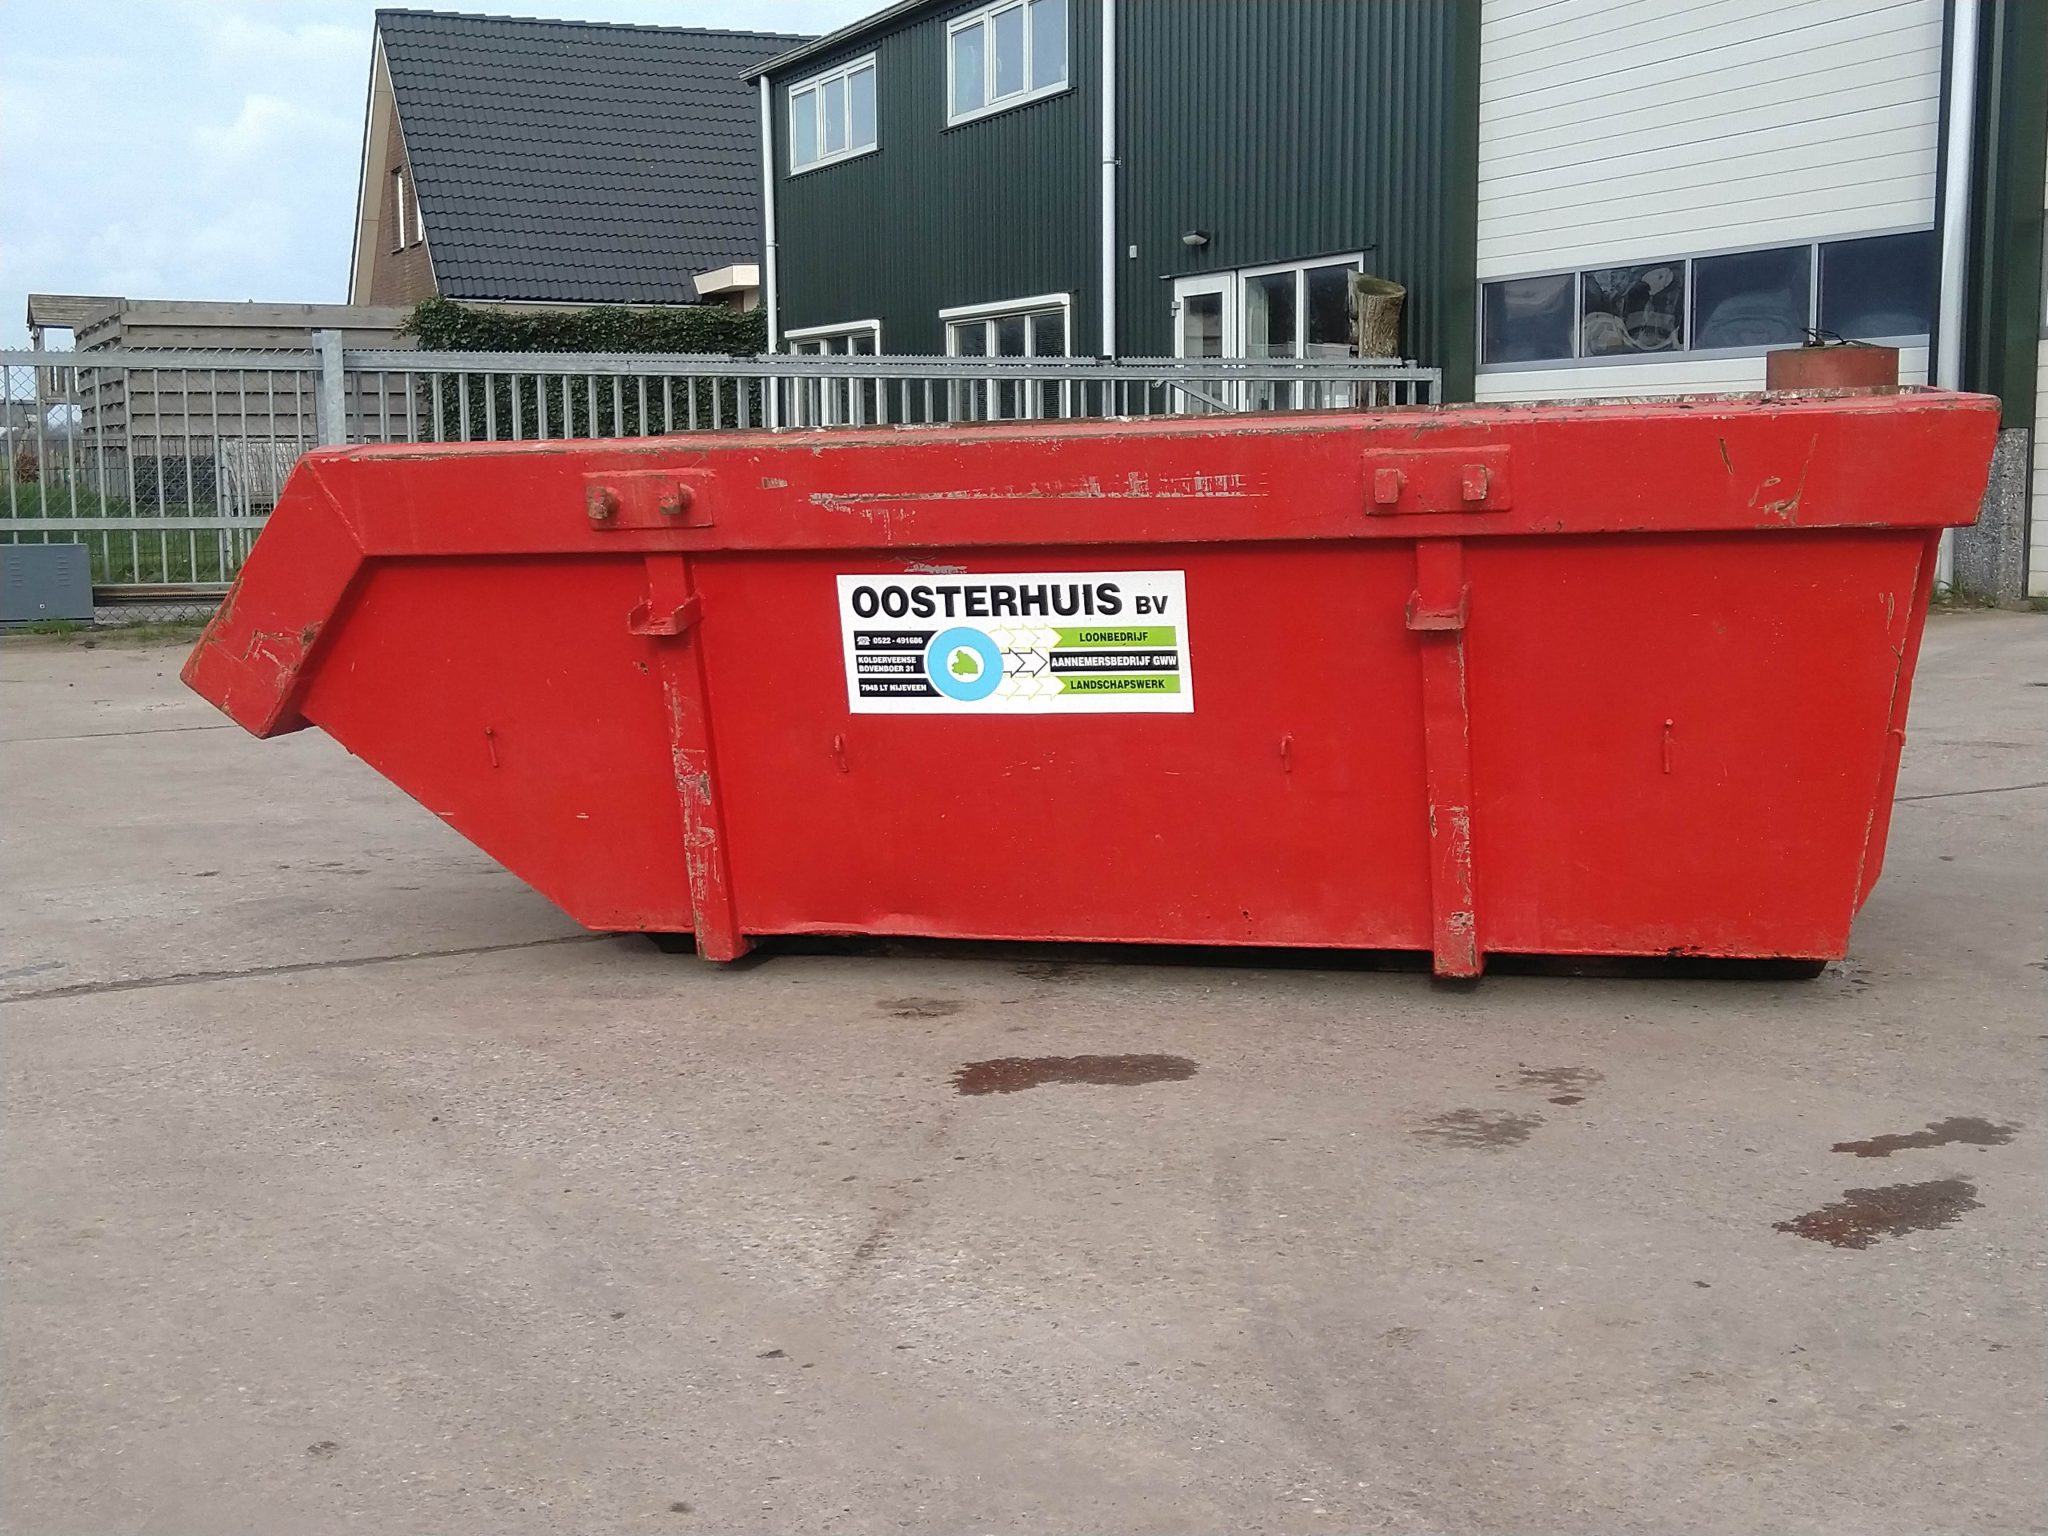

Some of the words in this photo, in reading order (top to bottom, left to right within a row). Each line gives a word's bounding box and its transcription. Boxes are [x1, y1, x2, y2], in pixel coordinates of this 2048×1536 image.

[852, 583, 1123, 618] OOSTERHUIS
[1135, 595, 1169, 615] BV
[1079, 632, 1149, 642] LOONBEDRIJF
[858, 656, 917, 664] KOLDERVEENSE
[1051, 656, 1151, 667] AANNEMERSBEDRIJF
[1152, 656, 1177, 666] GWW
[1070, 680, 1165, 690] LANDSCHAPSWERK
